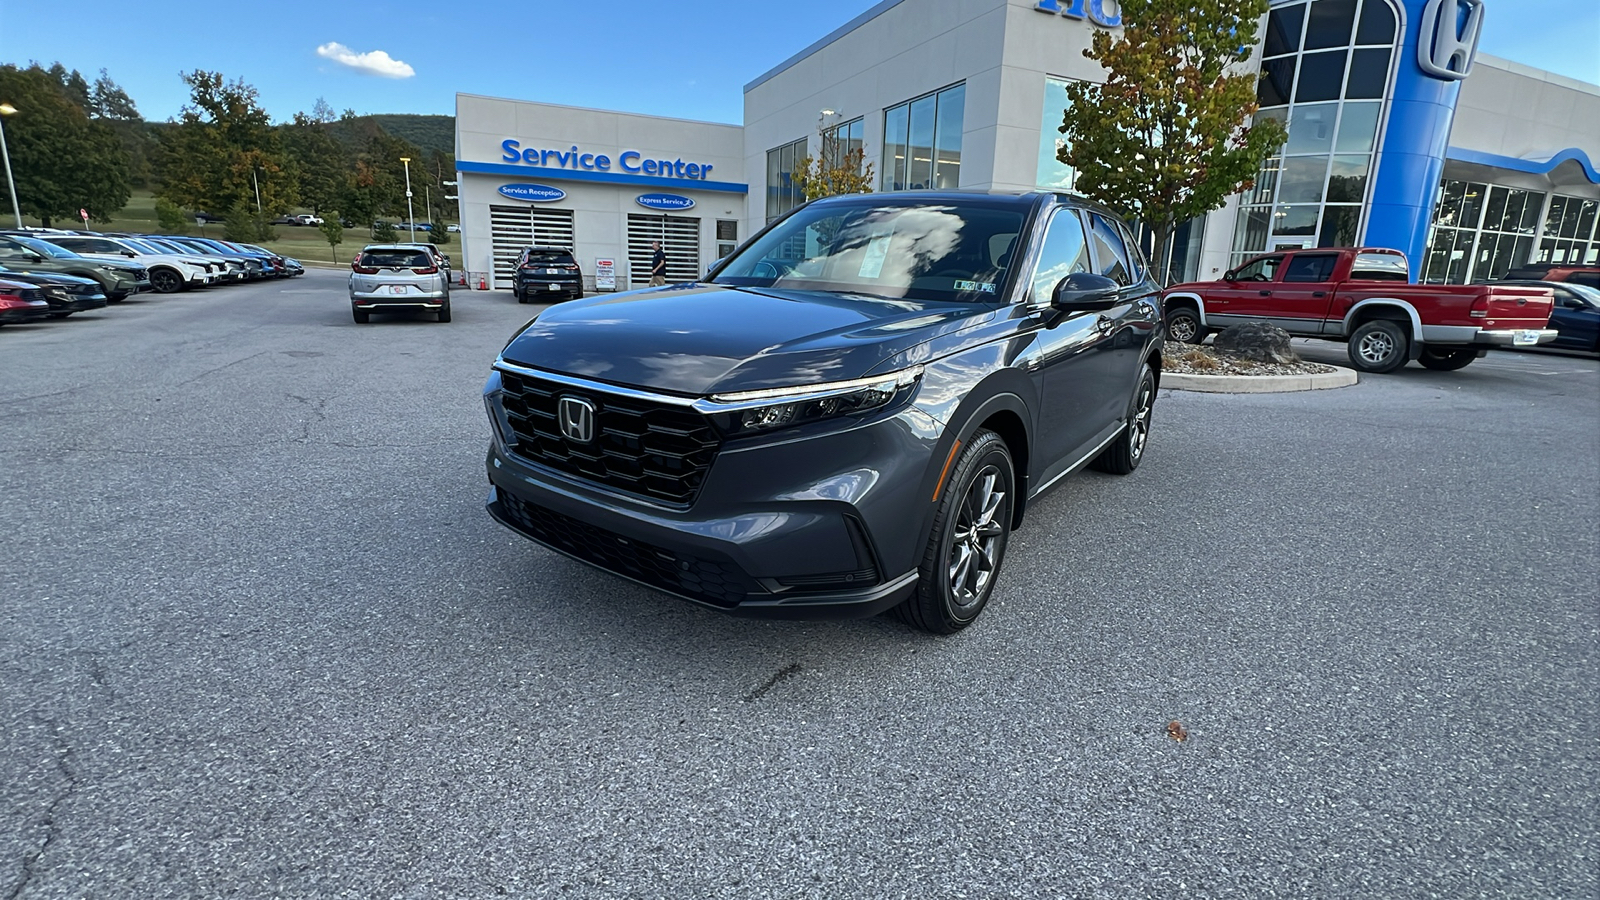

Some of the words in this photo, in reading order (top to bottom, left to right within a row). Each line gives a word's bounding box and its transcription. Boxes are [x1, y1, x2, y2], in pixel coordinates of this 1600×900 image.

[501, 139, 611, 171] Service
[619, 150, 713, 180] Center
[502, 186, 528, 195] Service
[528, 188, 562, 197] Reception
[639, 196, 661, 204] Express
[662, 197, 683, 206] Service
